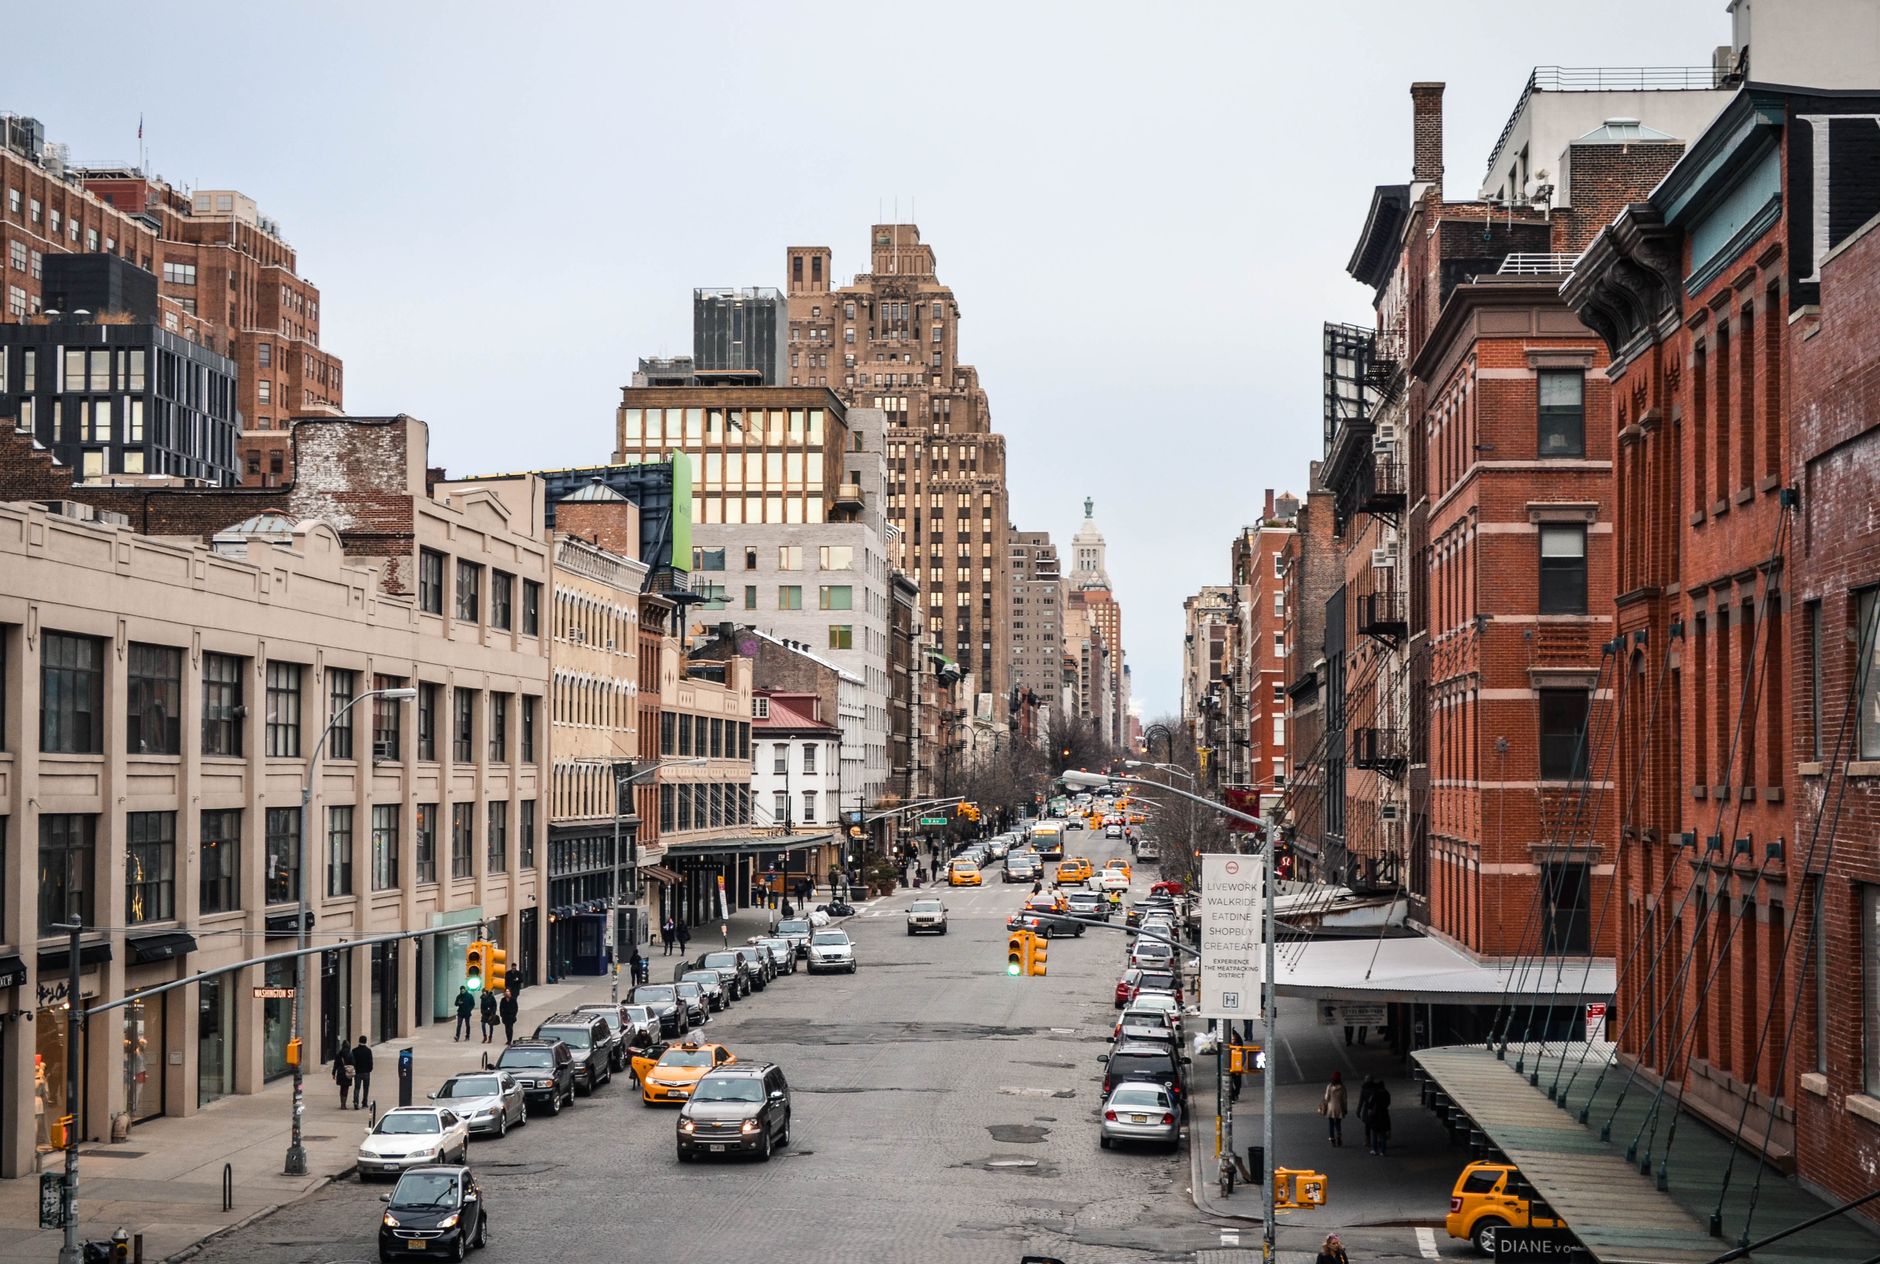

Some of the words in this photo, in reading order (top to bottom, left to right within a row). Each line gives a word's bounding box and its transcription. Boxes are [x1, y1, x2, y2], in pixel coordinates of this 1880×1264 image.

[1207, 882, 1258, 891] LIVEWORK
[1207, 897, 1257, 907] WALKRIDE
[1212, 912, 1252, 921] EATDINE
[1209, 927, 1255, 936] SHOPBUY
[1203, 942, 1259, 951] CREATEART
[254, 988, 286, 998] WASHINGTON
[403, 1057, 409, 1065] P
[1501, 1239, 1553, 1254] DIANE
